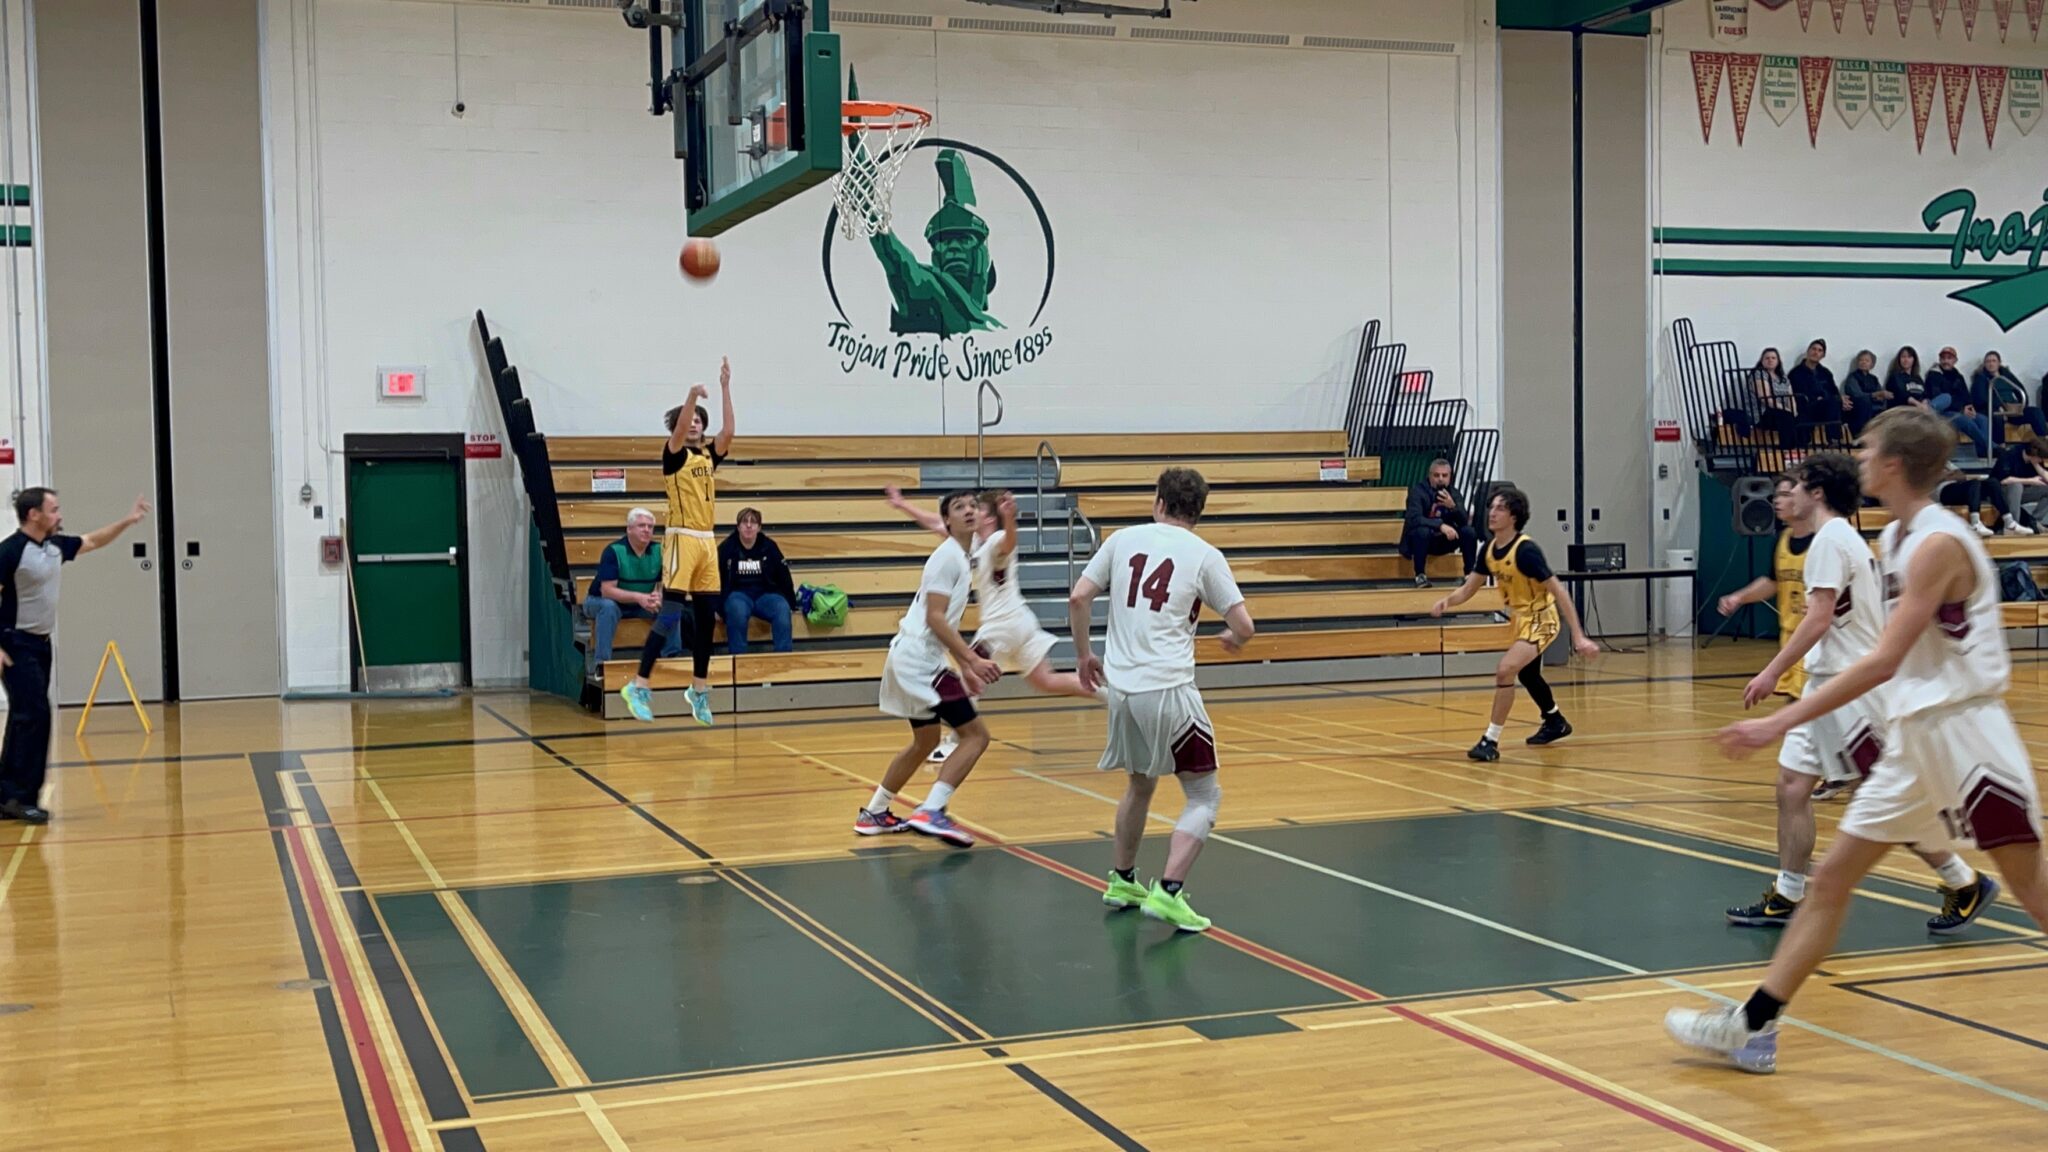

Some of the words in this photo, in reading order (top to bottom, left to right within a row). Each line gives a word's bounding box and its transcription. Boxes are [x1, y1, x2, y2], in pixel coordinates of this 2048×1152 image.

[828, 322, 888, 373] Trojan
[892, 341, 951, 380] Pride
[956, 336, 1013, 381] Since
[1014, 326, 1052, 364] 1895
[470, 434, 496, 442] STOP
[1126, 552, 1175, 613] 14
